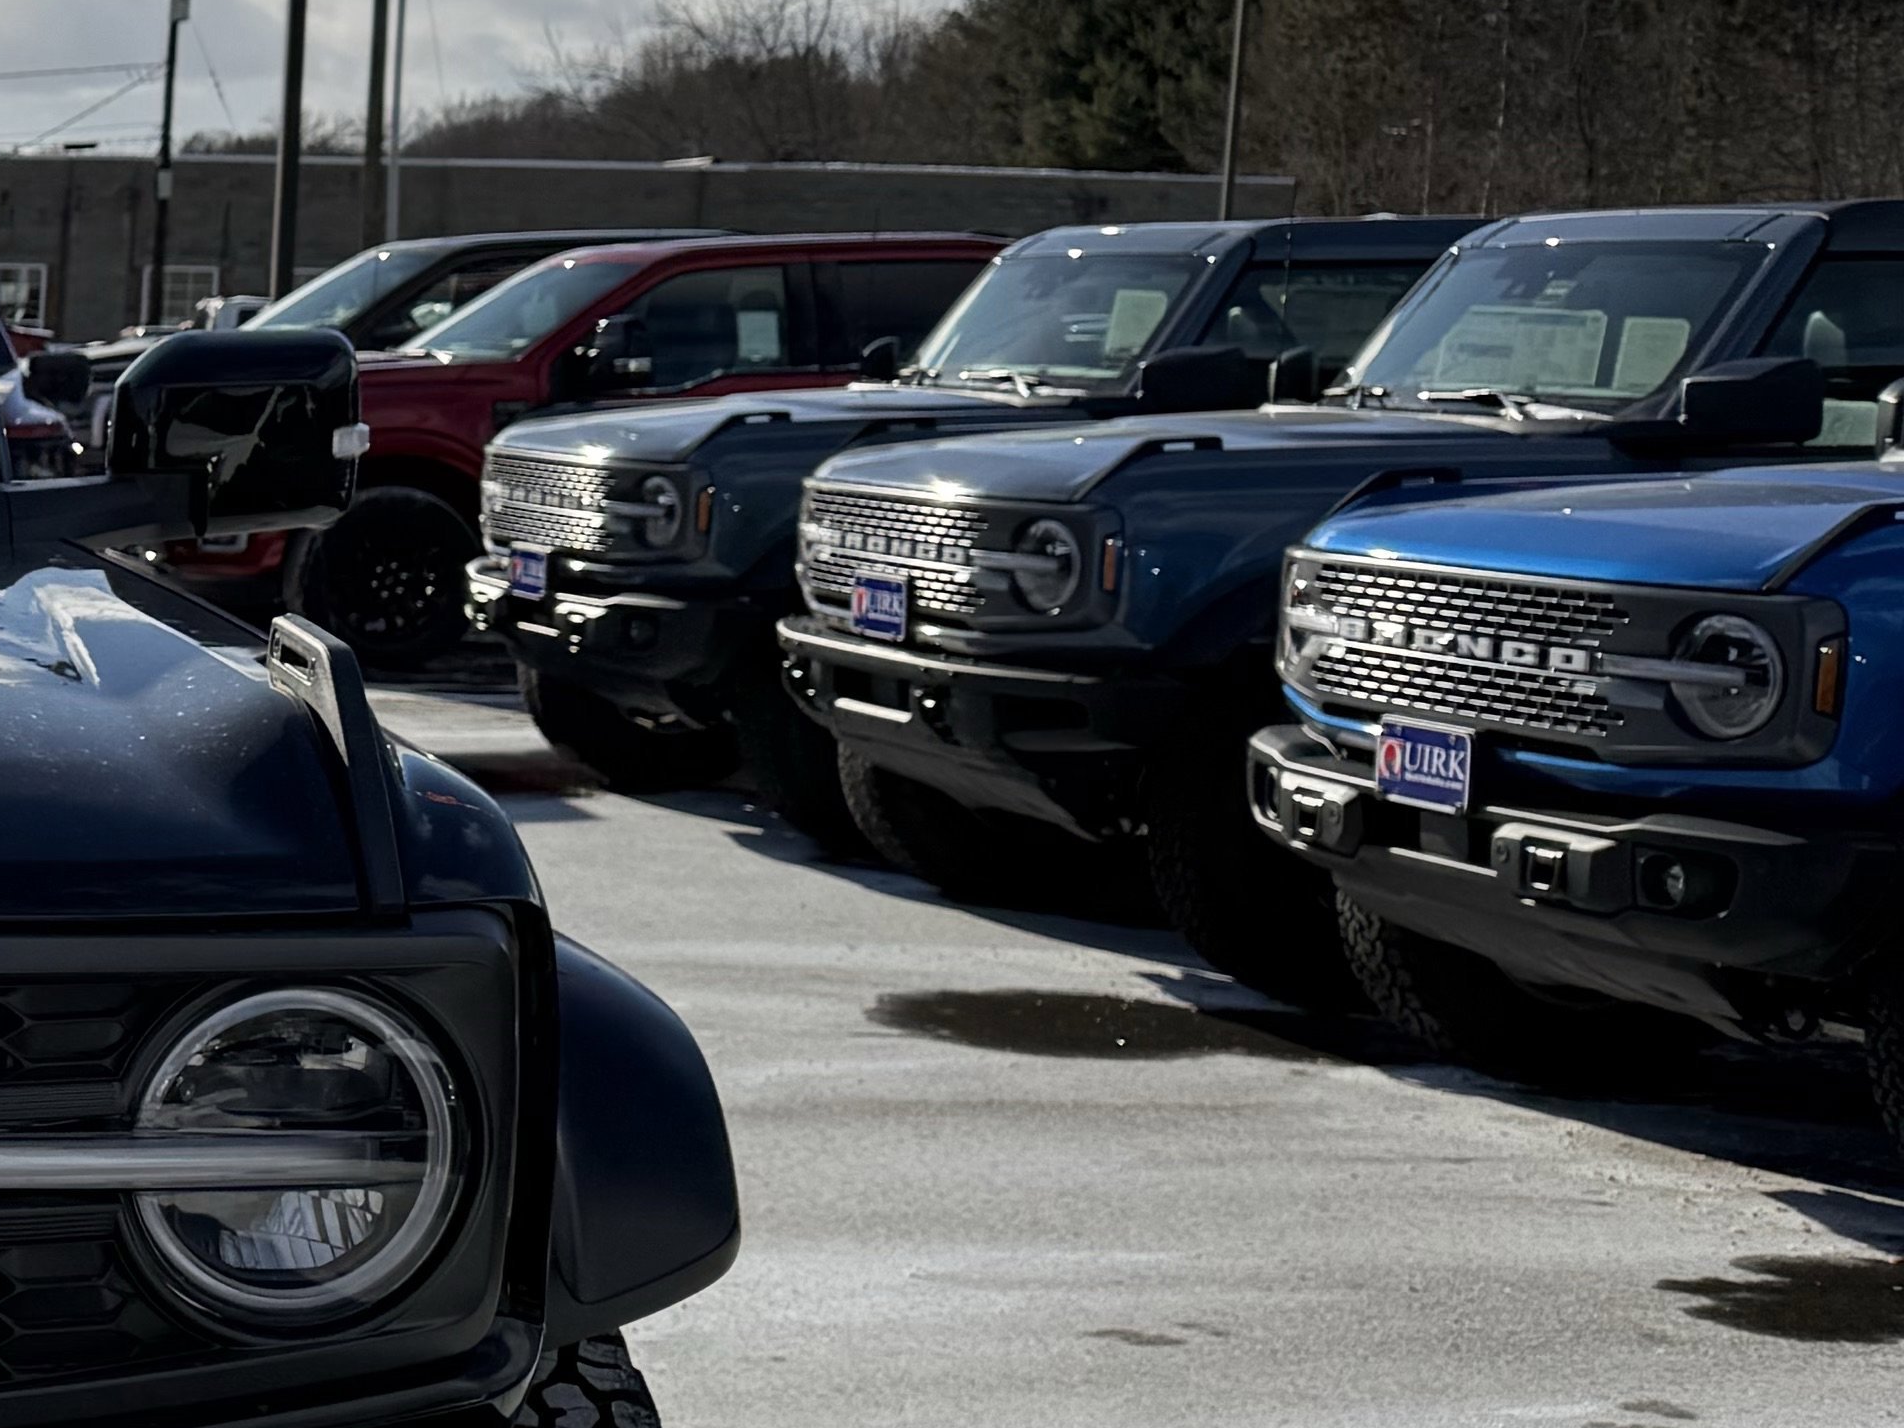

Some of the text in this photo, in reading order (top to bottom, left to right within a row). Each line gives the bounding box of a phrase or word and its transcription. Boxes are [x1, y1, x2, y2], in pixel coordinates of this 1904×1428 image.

[819, 528, 967, 564] BRONCO
[1337, 617, 1590, 672] BRONCO
[1379, 737, 1466, 780] QUIRK
